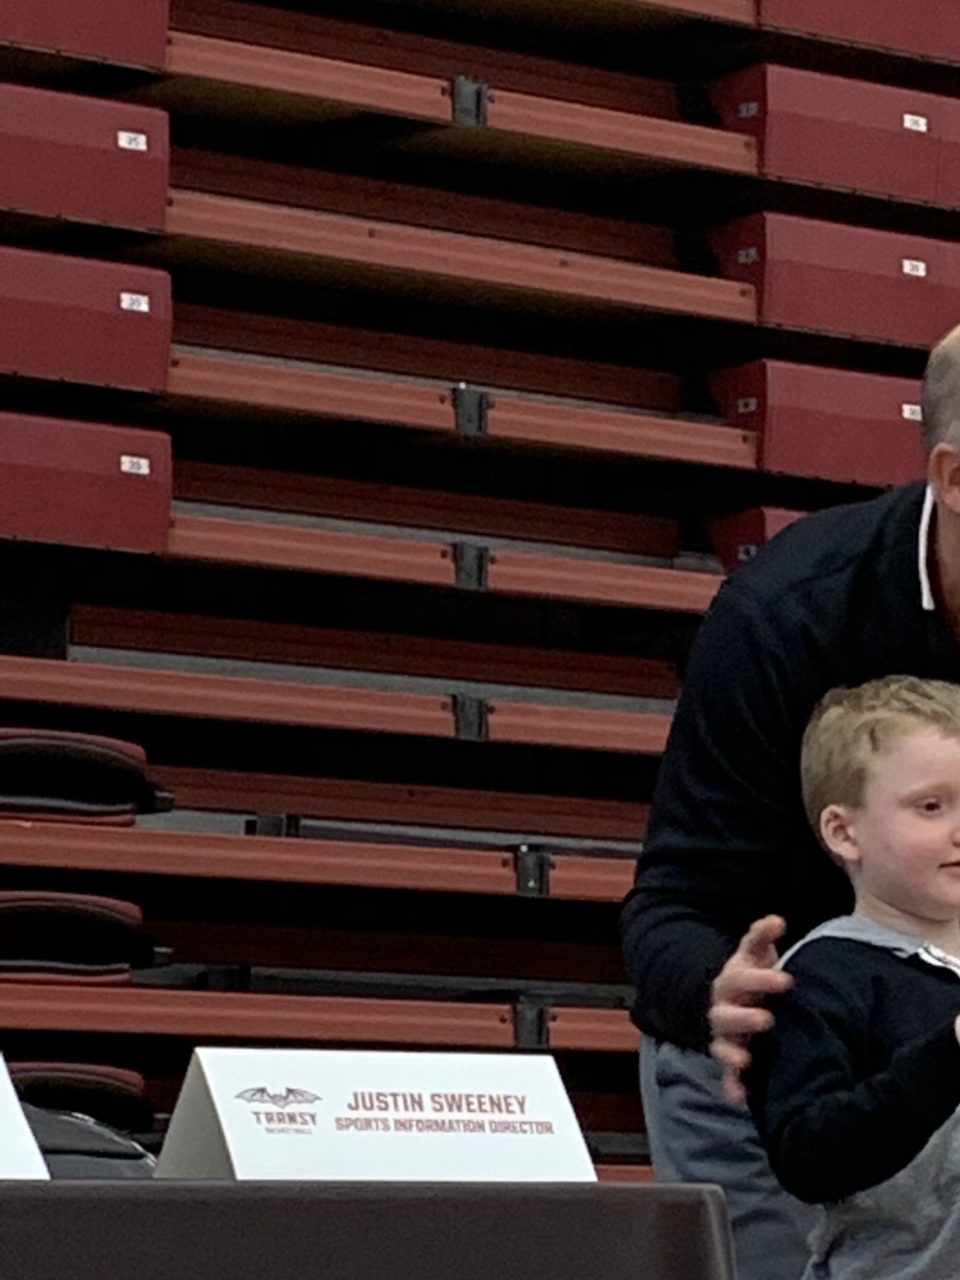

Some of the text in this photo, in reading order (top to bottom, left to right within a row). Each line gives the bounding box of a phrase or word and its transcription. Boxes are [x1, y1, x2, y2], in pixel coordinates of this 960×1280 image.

[347, 1091, 526, 1114] JUSTIN SWEENEY
[252, 1111, 317, 1126] TRANSY
[334, 1117, 554, 1135] SPORTS INFORMATION DIRECTOR
